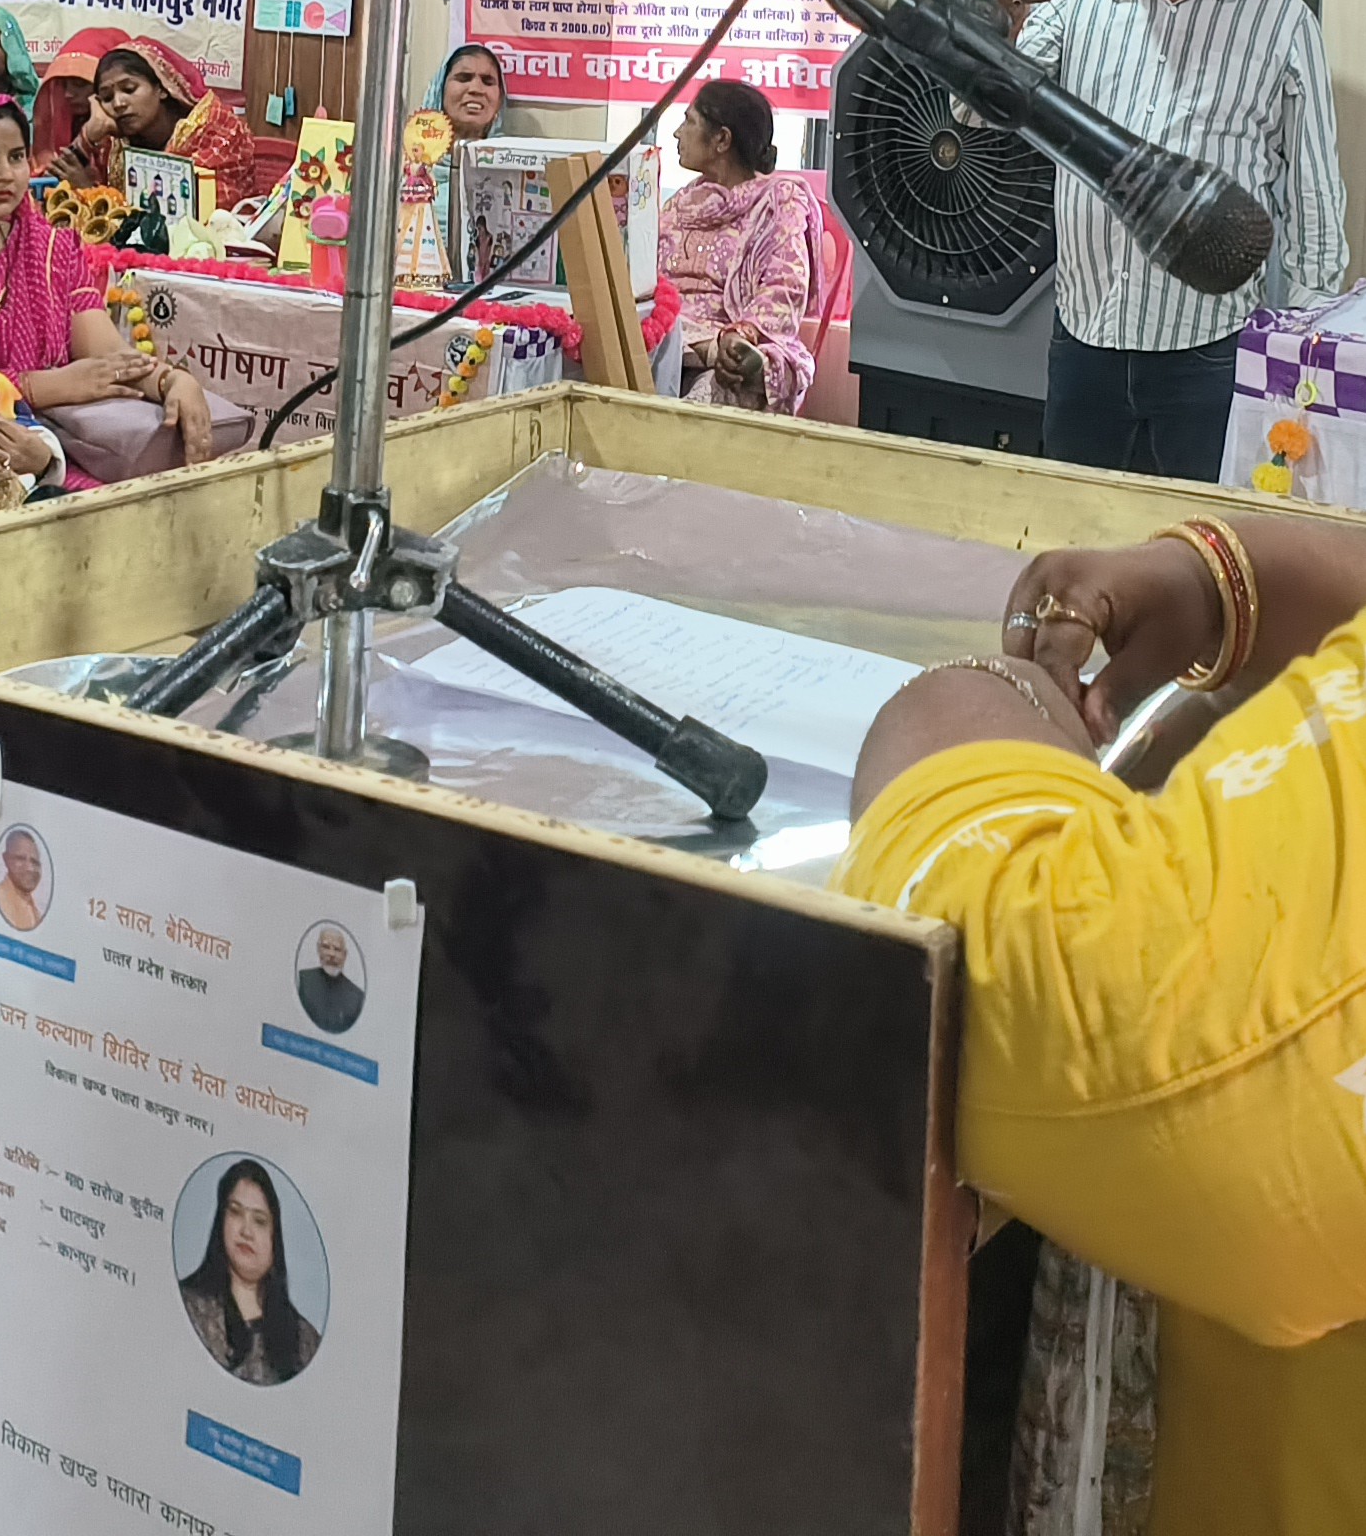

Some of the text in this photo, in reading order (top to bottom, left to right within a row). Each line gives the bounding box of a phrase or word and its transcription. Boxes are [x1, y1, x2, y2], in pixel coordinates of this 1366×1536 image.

[197, 332, 290, 390] पोषण
[88, 897, 233, 960] 12 साल, बेमिशाल
[102, 946, 208, 995] उत्तर प्रदेश सरकार
[0, 1002, 310, 1128] जन कल्याण शिविर एवं मेला आयोजन
[44, 1059, 78, 1087] विकास
[82, 1075, 108, 1098] खण्ड
[143, 1097, 180, 1127] कानपुर
[3, 1145, 41, 1173] अतिथि
[89, 1180, 124, 1206] सरोज
[128, 1193, 165, 1222] कुरील
[57, 1241, 97, 1273] कानपुर
[1, 1419, 51, 1467] विकास
[59, 1452, 98, 1489] खण्ड
[106, 1475, 152, 1515] पतारा
